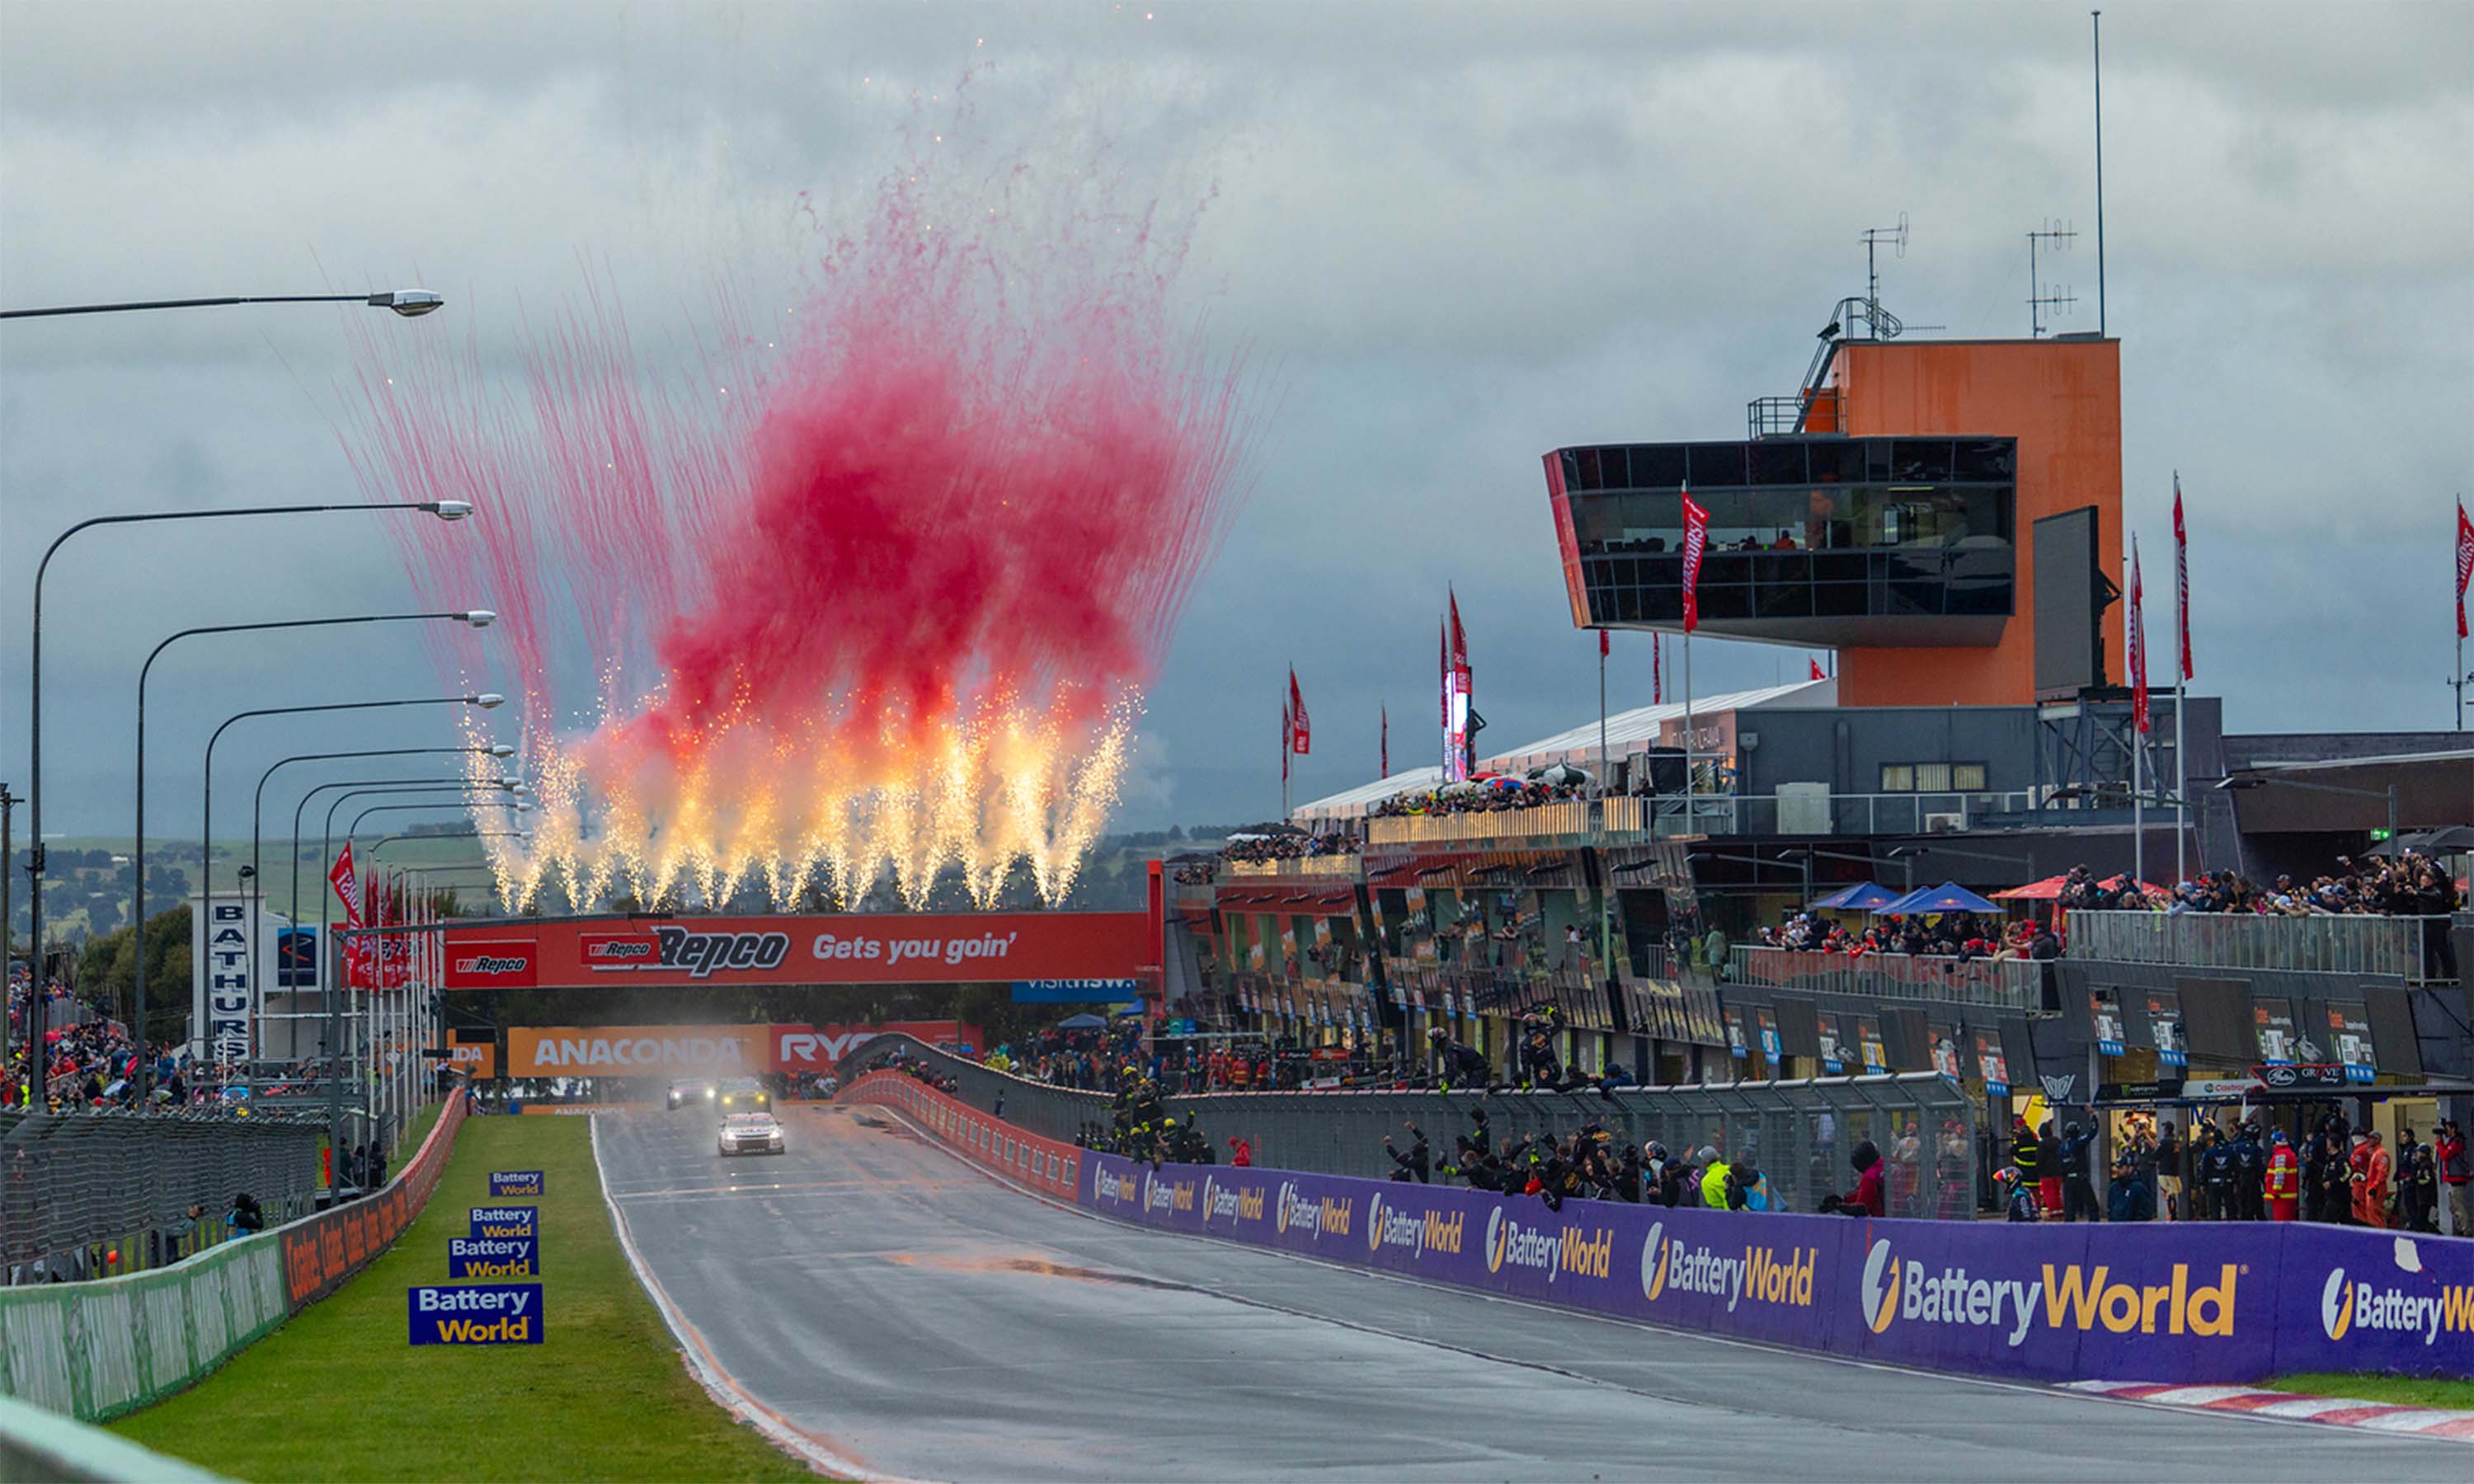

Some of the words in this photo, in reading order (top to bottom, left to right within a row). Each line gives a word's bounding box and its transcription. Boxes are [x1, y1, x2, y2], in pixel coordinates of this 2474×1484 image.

[605, 942, 651, 957] Repco
[659, 927, 788, 976] Repco
[813, 934, 881, 959] Gets
[887, 938, 940, 965] you
[945, 932, 1017, 965] goin'
[475, 956, 527, 974] Repco
[212, 906, 247, 1057] BATHURS
[534, 1038, 741, 1066] ANACONDA
[2215, 1083, 2245, 1092] Castrol
[493, 1172, 539, 1184] Battery
[501, 1184, 539, 1195] World
[473, 1209, 532, 1223] Battery
[482, 1224, 532, 1237] World
[452, 1239, 530, 1258] Battery
[464, 1259, 529, 1277] World
[419, 1289, 529, 1315] Battery
[2355, 1282, 2474, 1345] BatteryW
[436, 1316, 528, 1342] World
